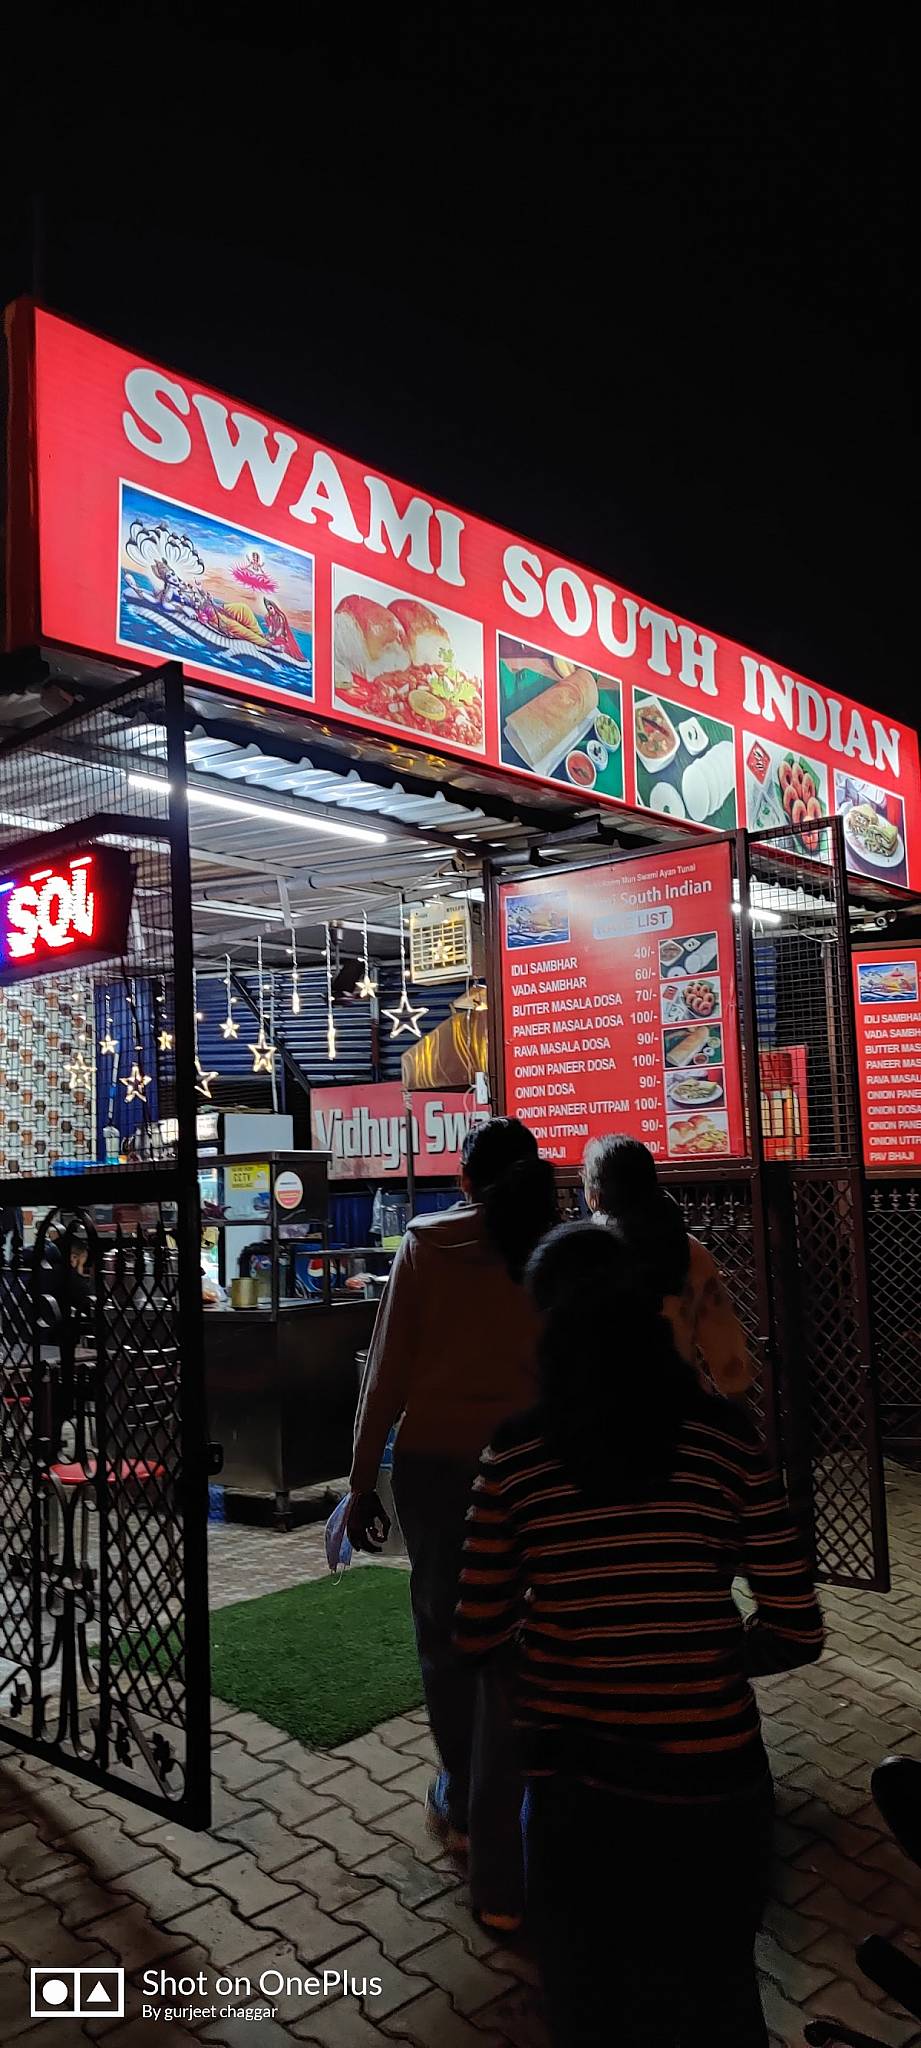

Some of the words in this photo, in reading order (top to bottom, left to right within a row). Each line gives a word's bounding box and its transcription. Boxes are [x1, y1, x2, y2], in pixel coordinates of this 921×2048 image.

[122, 368, 466, 587] SWAMI
[502, 545, 719, 697] SOUTH
[740, 655, 901, 778] INDIAN
[637, 871, 658, 882] Swami
[659, 868, 676, 879] Ayan
[621, 886, 661, 905] South
[665, 880, 712, 900] Indian
[638, 911, 668, 928] LIST
[511, 964, 528, 977] IDLI
[530, 957, 578, 974] SAMBHAR
[634, 946, 655, 959] 40/-
[512, 984, 537, 997] VADA
[539, 977, 587, 994] SAMBHAR
[635, 968, 656, 981] 60/-
[512, 1002, 550, 1017] BUTTER
[552, 996, 592, 1013] MASALA
[594, 993, 623, 1008] DOSA
[636, 990, 657, 1002] 70/-
[513, 1023, 551, 1037] PANEER
[553, 1018, 593, 1033] MASALA
[595, 1014, 624, 1028] DOSA
[630, 1011, 658, 1024] 100/-
[864, 1014, 880, 1024] IDLI
[864, 1030, 889, 1039] VADA
[514, 1045, 539, 1058] RAVA
[540, 1040, 581, 1055] MASALA
[582, 1037, 611, 1051] DOSA
[637, 1032, 659, 1045] 90/-
[865, 1044, 900, 1054] BUTTER
[515, 1066, 545, 1079] ONION
[547, 1061, 585, 1075] PANEER
[587, 1058, 616, 1072] DOSA
[632, 1054, 660, 1067] 100/-
[866, 1060, 901, 1070] PANEER
[515, 1086, 546, 1099] ONION
[547, 1083, 576, 1096] DOSA
[639, 1076, 661, 1088] 90/-
[866, 1076, 890, 1085] RAVA
[867, 1091, 896, 1100] ONION
[516, 1106, 547, 1119] ONION
[549, 1102, 587, 1117] PANEER
[589, 1100, 630, 1114] UTTPAM
[634, 1098, 662, 1111] 100/-
[867, 1106, 896, 1115] ONION
[549, 1122, 589, 1138] UTTPAM
[641, 1119, 663, 1132] 90/-
[868, 1121, 897, 1130] ONION
[869, 1137, 897, 1146] ONION
[537, 1146, 567, 1160] BHAJI
[870, 1152, 887, 1161] PAV
[888, 1151, 915, 1161] BHAJI
